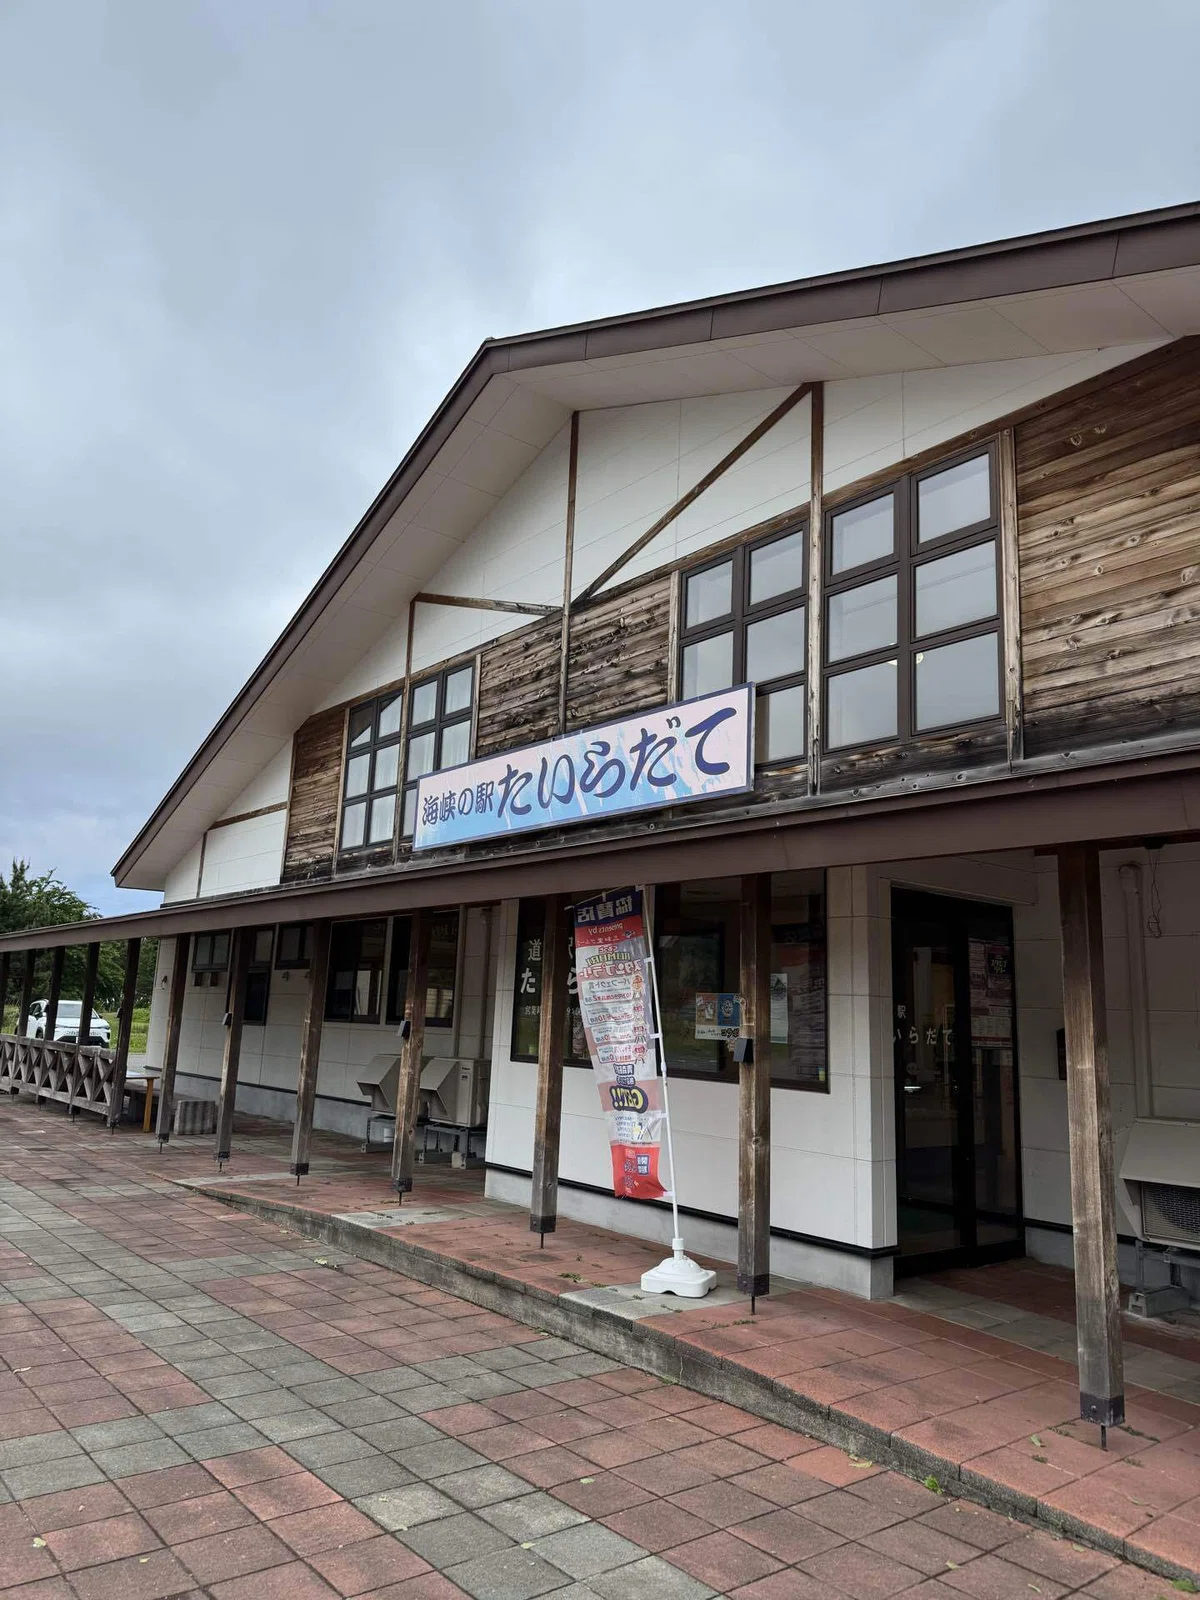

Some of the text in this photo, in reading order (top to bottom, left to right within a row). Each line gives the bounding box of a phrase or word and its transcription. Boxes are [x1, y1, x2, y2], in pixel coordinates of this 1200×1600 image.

[422, 707, 737, 826] 海峡の駅 たいらだて
